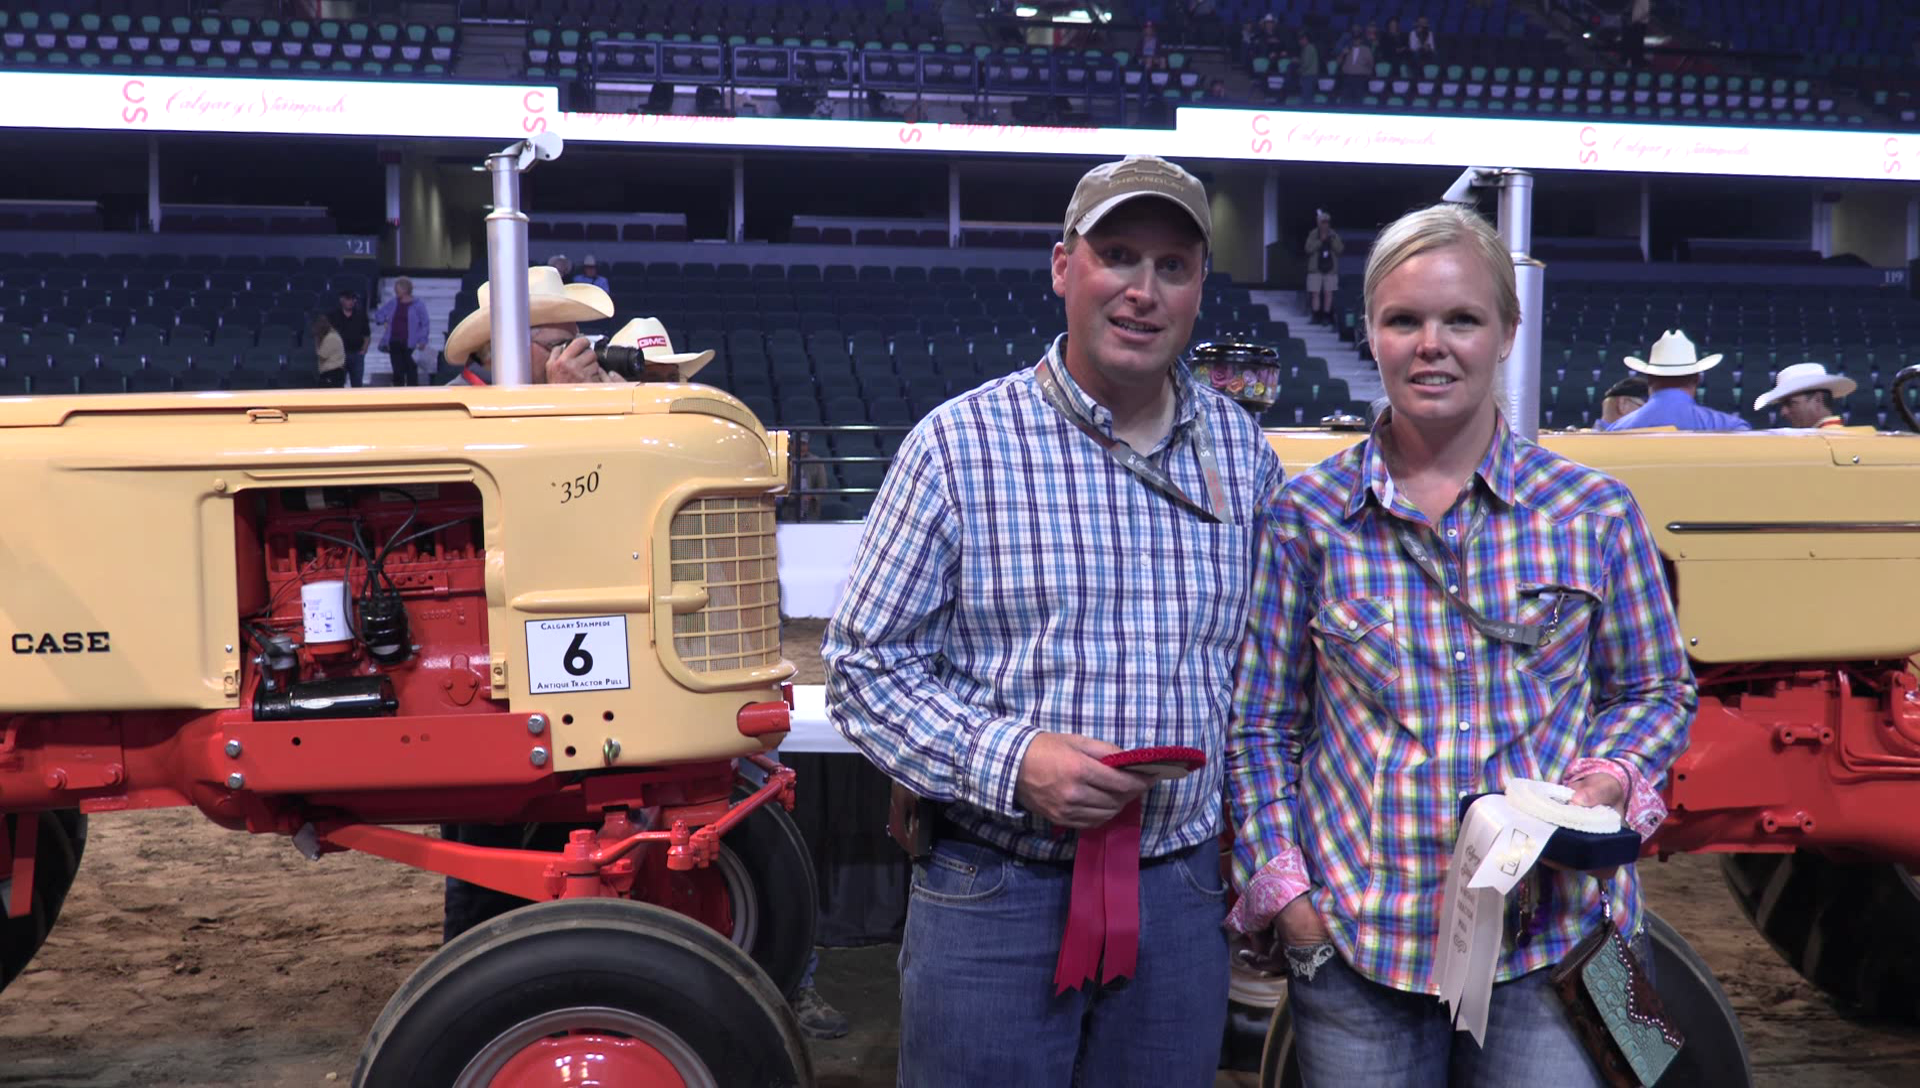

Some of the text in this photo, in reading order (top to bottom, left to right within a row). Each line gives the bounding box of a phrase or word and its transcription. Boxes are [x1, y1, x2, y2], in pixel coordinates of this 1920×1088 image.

[639, 337, 667, 347] GMC
[541, 620, 610, 630] CALGARY STAMPEDE
[12, 631, 111, 654] CASE
[563, 633, 594, 676] 6
[537, 678, 622, 690] ANTIQUE TRACTOR PULL
